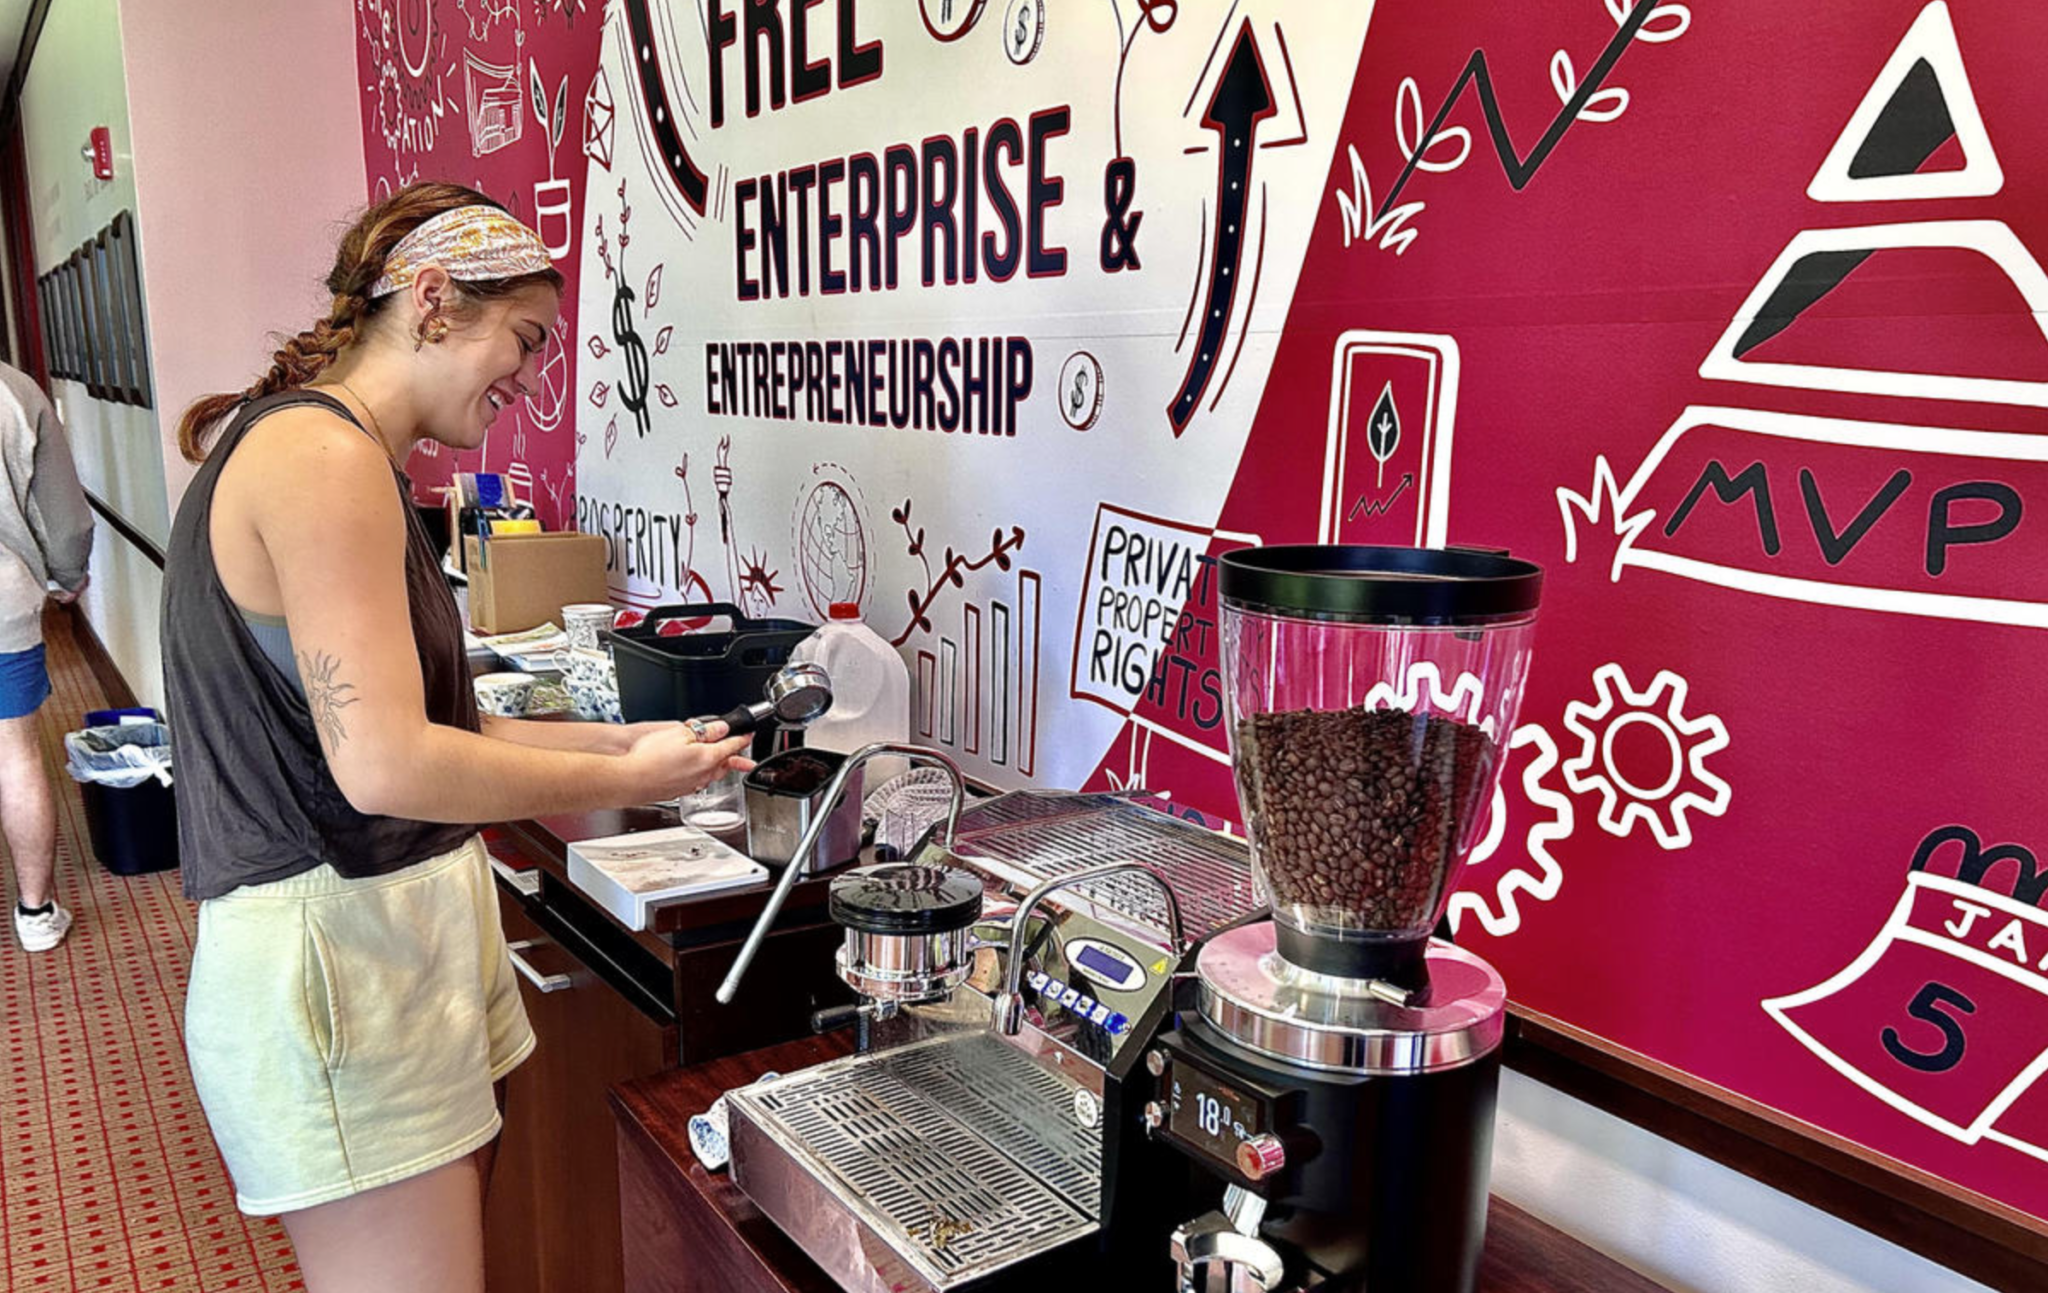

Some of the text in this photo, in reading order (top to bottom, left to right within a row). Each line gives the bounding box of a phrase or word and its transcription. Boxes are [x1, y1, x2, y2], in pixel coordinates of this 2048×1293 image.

[734, 104, 1144, 302] ENTERPRISE &
[705, 335, 1034, 437] ENTREPRENEURSHIP
[568, 493, 682, 592] PROSPERITY
[1100, 524, 1218, 607] PRIVAT
[1663, 459, 2024, 577] MVP
[1090, 629, 1224, 729] RIGHTS
[1944, 899, 2048, 972] JA
[1879, 980, 1978, 1073] 5
